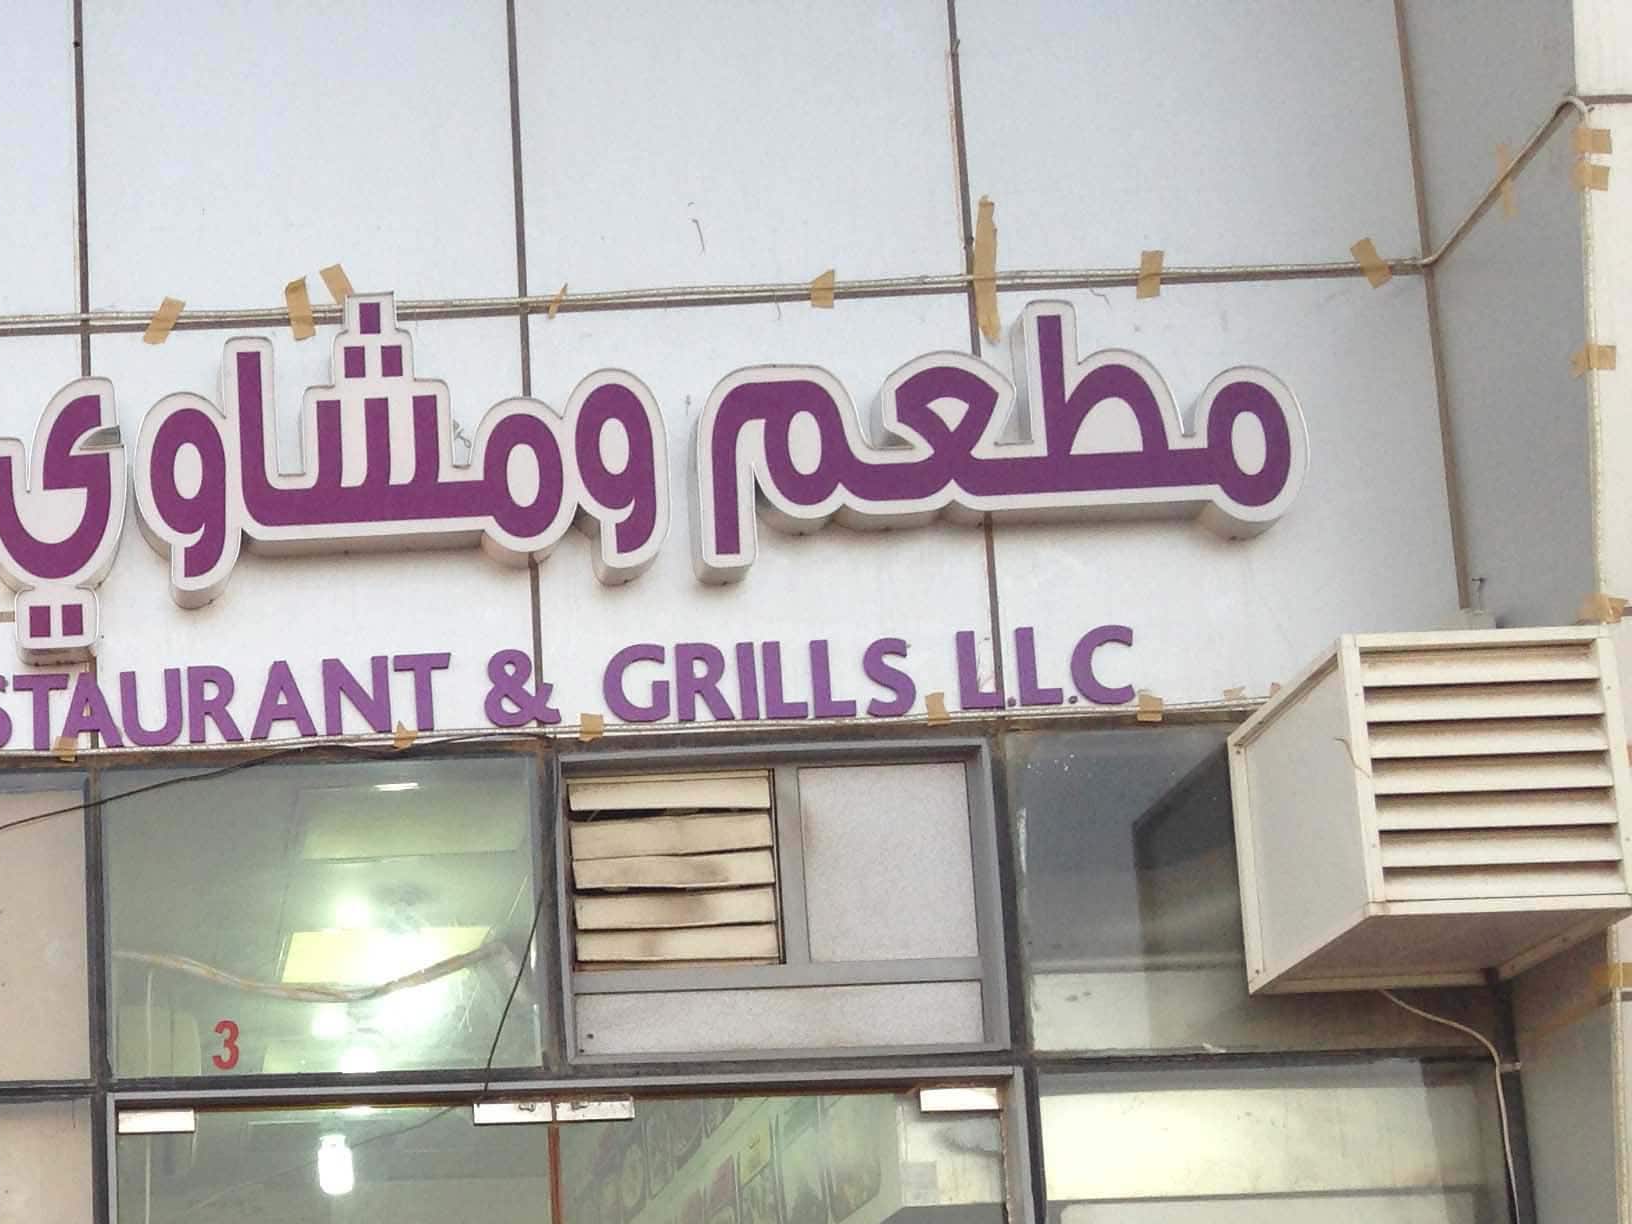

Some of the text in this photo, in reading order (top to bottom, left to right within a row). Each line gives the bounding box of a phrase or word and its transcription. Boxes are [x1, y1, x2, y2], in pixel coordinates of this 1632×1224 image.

[711, 315, 1291, 556] مطعم
[484, 648, 561, 728] &
[603, 636, 917, 722] GRILLS
[212, 1020, 240, 1070] 3
